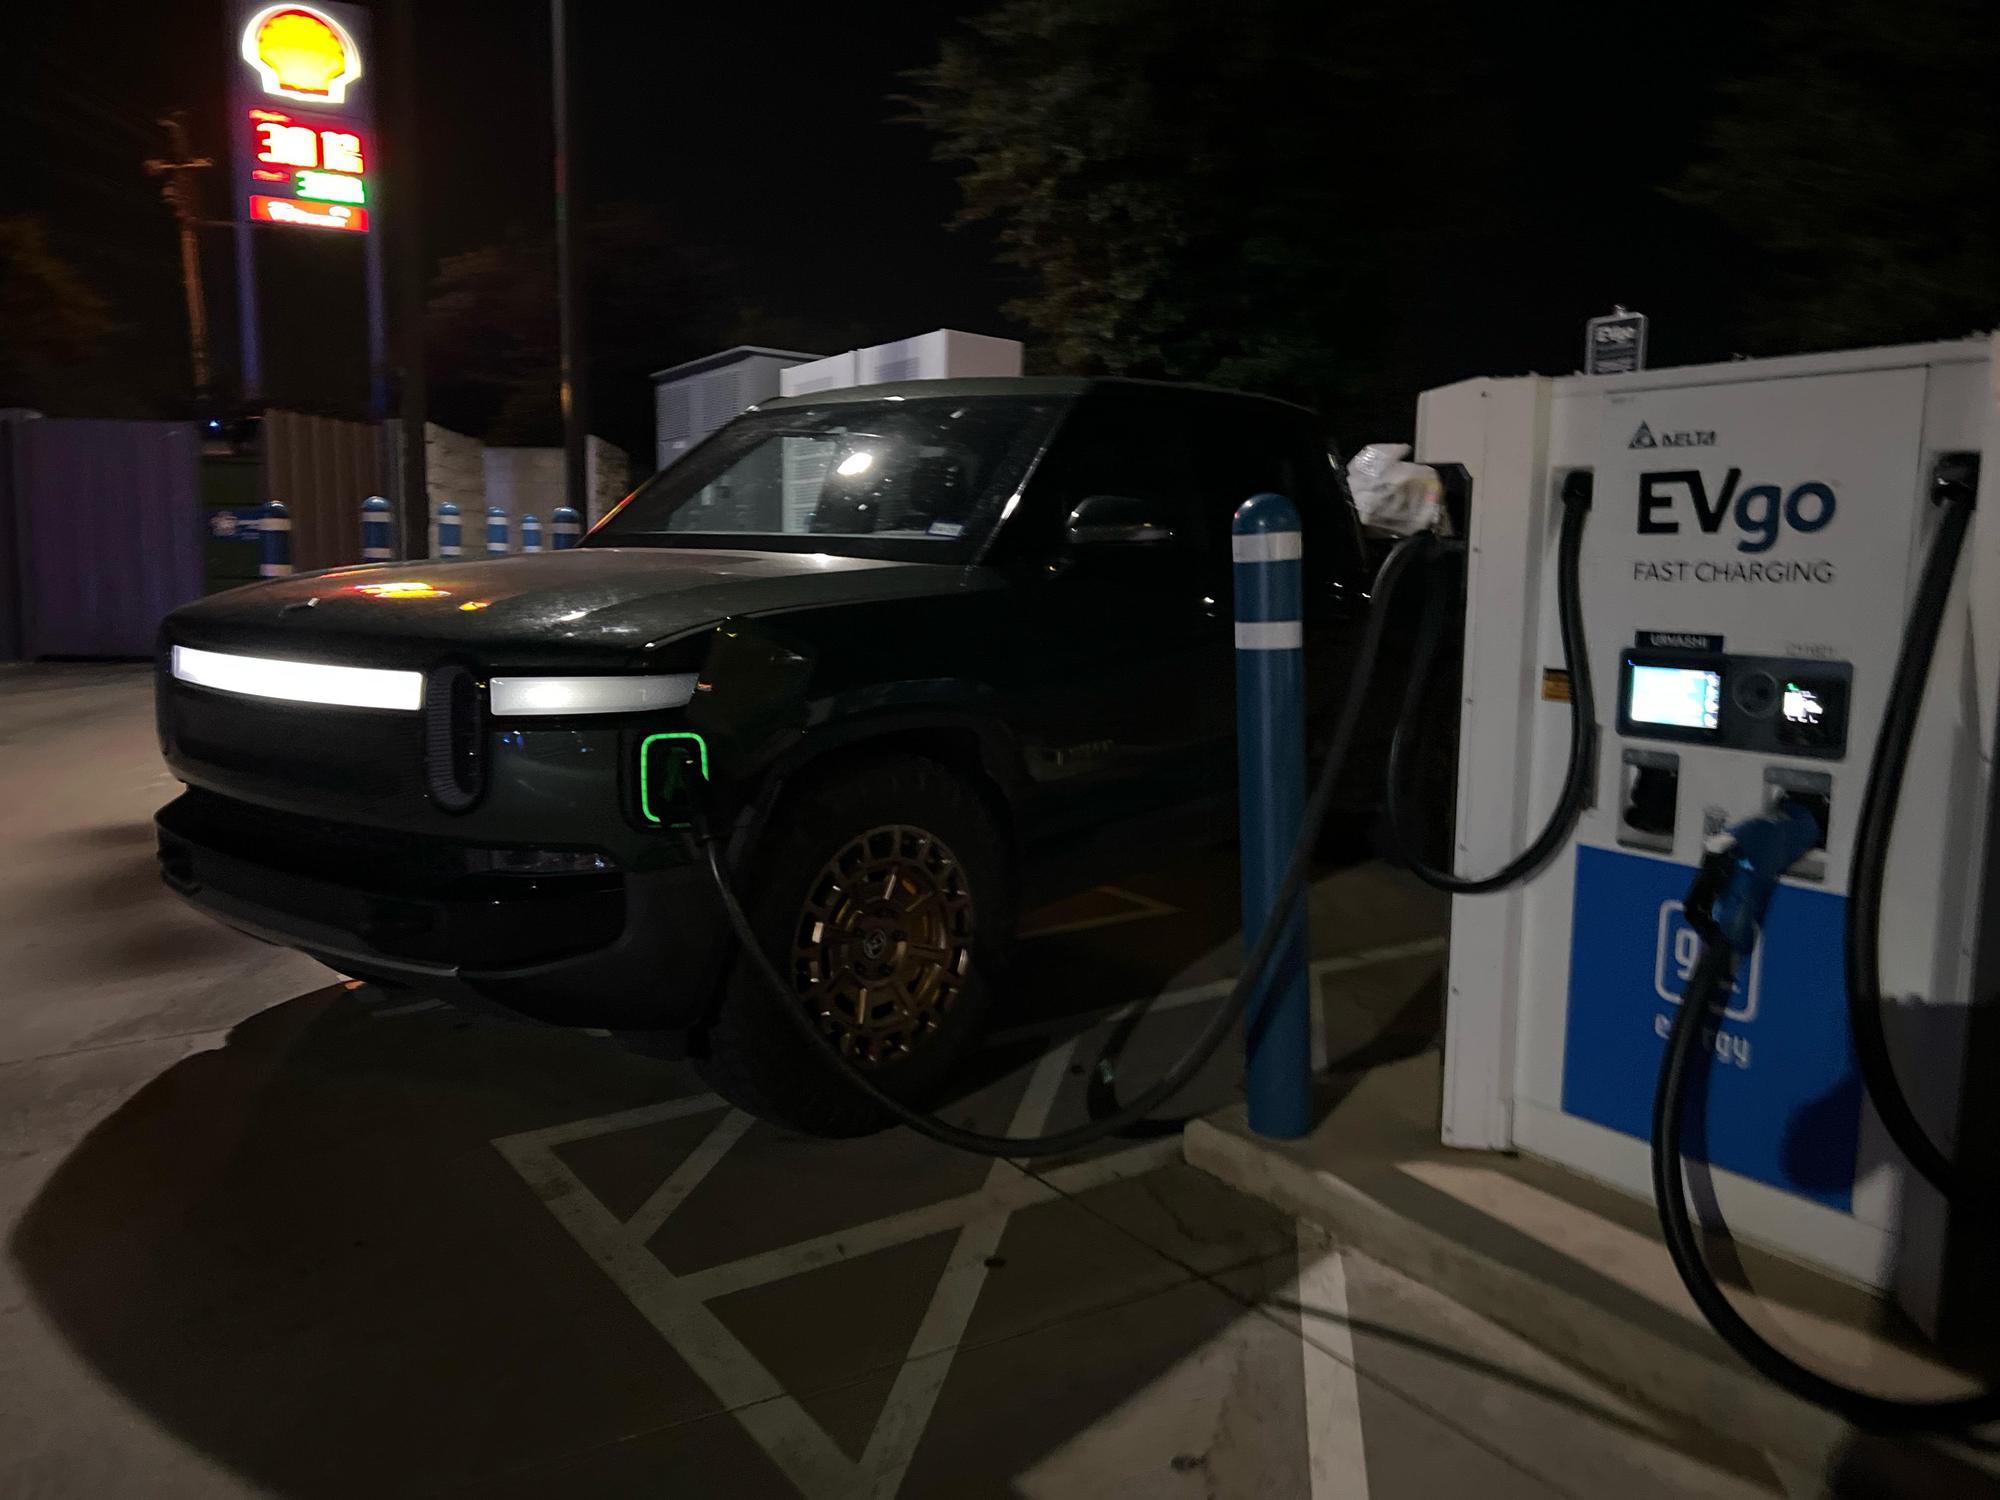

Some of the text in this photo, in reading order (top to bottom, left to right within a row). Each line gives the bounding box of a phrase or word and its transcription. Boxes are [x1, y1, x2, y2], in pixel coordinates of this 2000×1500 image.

[1637, 467, 1837, 554] EVgo
[1634, 561, 1835, 583] FAST CHARGING
